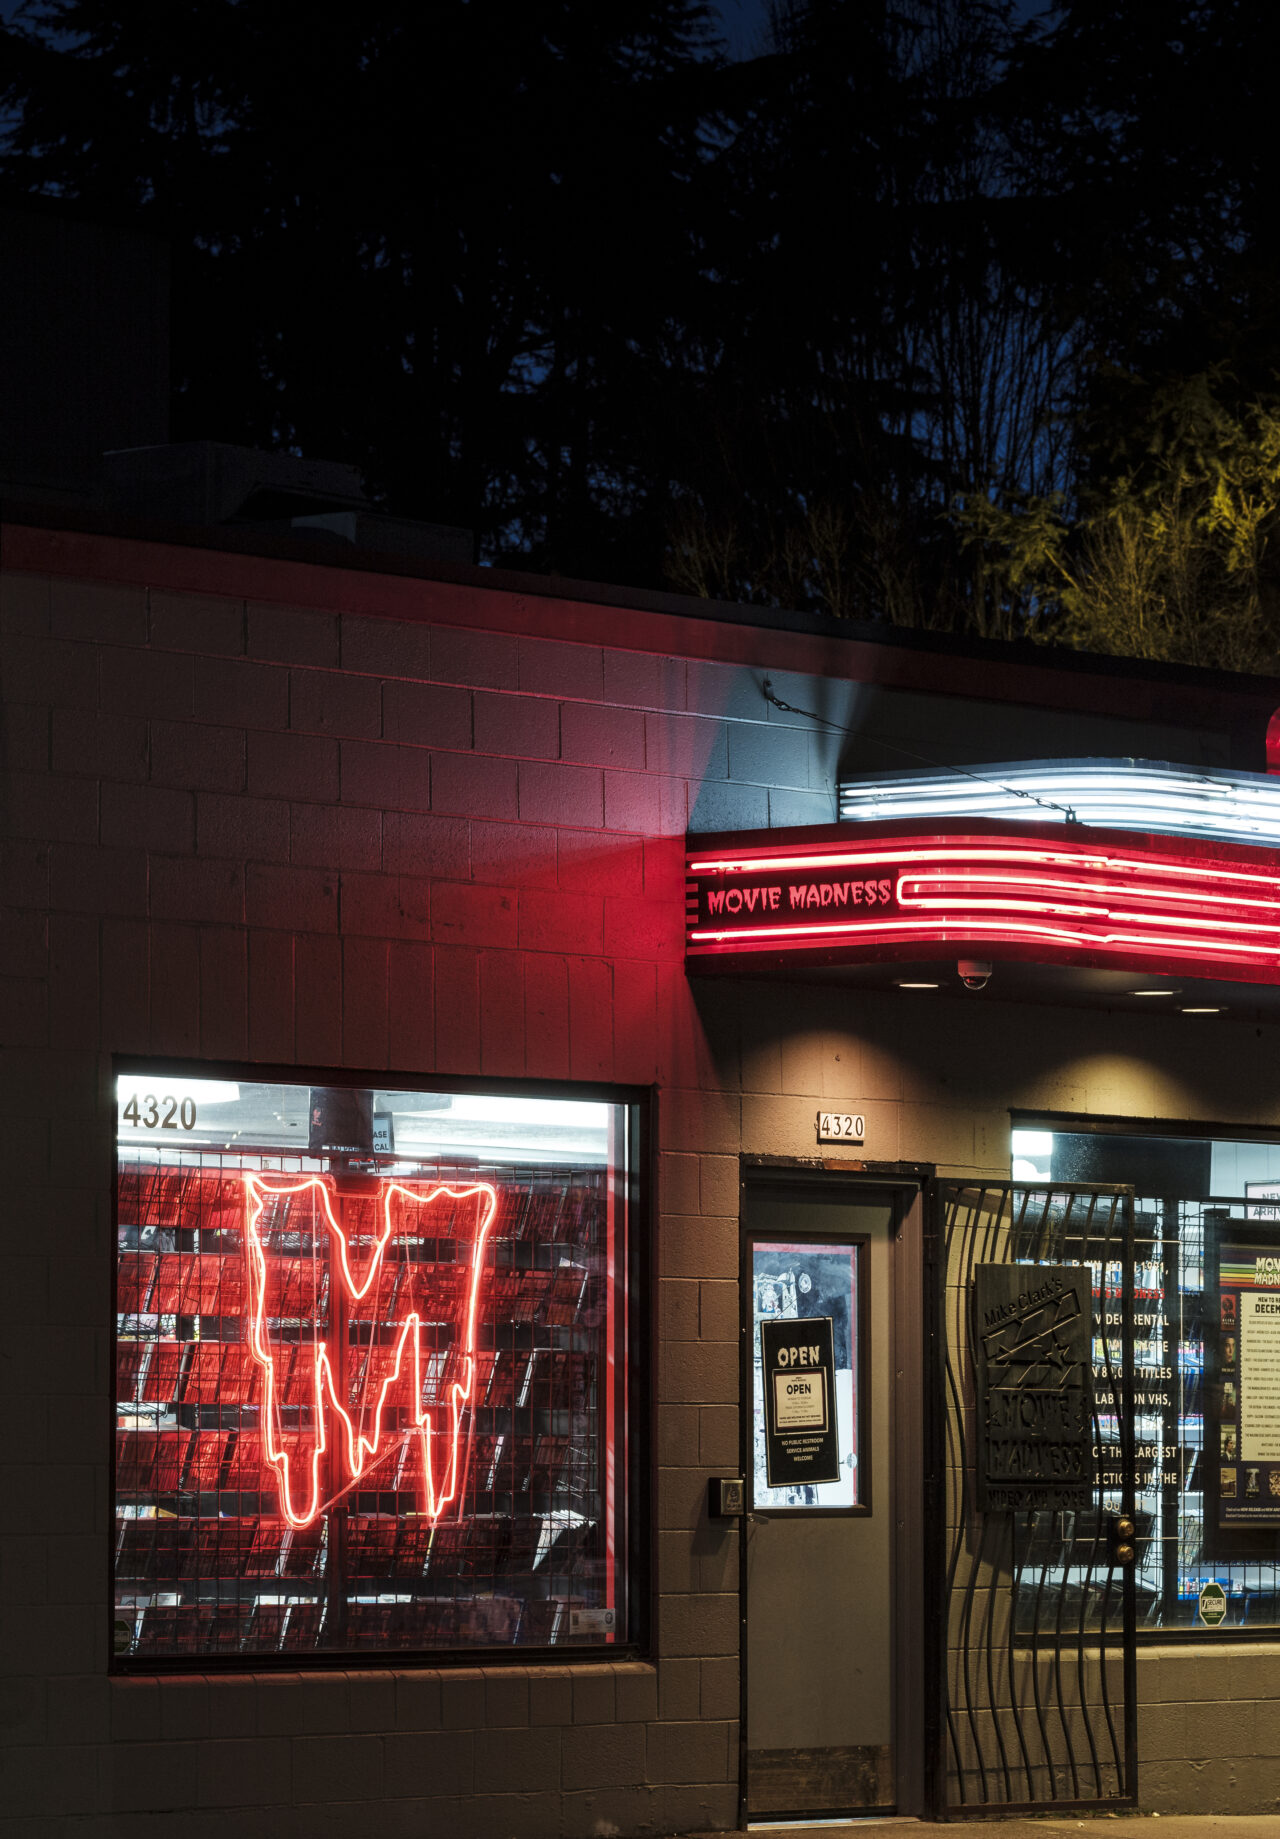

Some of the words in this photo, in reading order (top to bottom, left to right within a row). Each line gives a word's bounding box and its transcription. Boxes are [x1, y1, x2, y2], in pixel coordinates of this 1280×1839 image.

[707, 887, 782, 915] MOVIE
[789, 879, 892, 910] MADNESS
[123, 1094, 197, 1131] 4320
[822, 1115, 864, 1137] 4320
[1115, 1287, 1166, 1300] MDNESS
[984, 1302, 1017, 1328] Mike
[1018, 1277, 1063, 1311] Clark's
[777, 1345, 820, 1367] OPEN
[1140, 1367, 1172, 1379] TITLES
[786, 1383, 811, 1395] OPEN
[1148, 1393, 1171, 1406] VHS,
[1135, 1447, 1177, 1458] ARGEST
